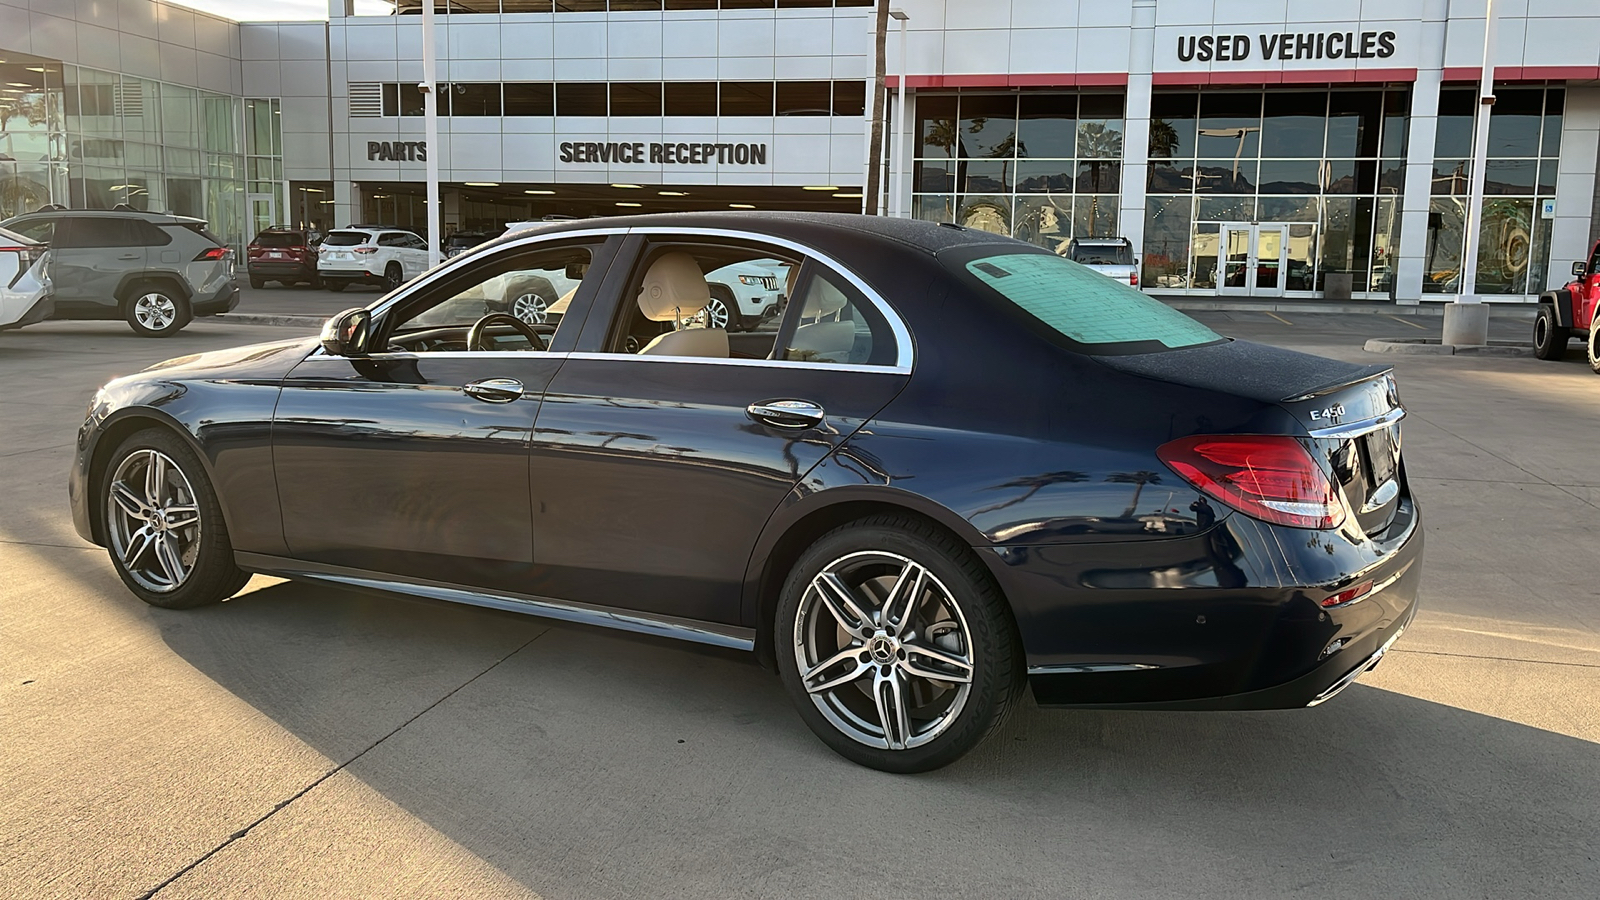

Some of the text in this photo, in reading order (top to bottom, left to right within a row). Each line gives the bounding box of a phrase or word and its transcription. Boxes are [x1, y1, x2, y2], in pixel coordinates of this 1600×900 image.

[1177, 31, 1396, 62] USED VEHICLES
[367, 141, 427, 161] PARTS
[559, 142, 767, 164] SERVICE RECEPTION
[1310, 405, 1346, 421] E 450
